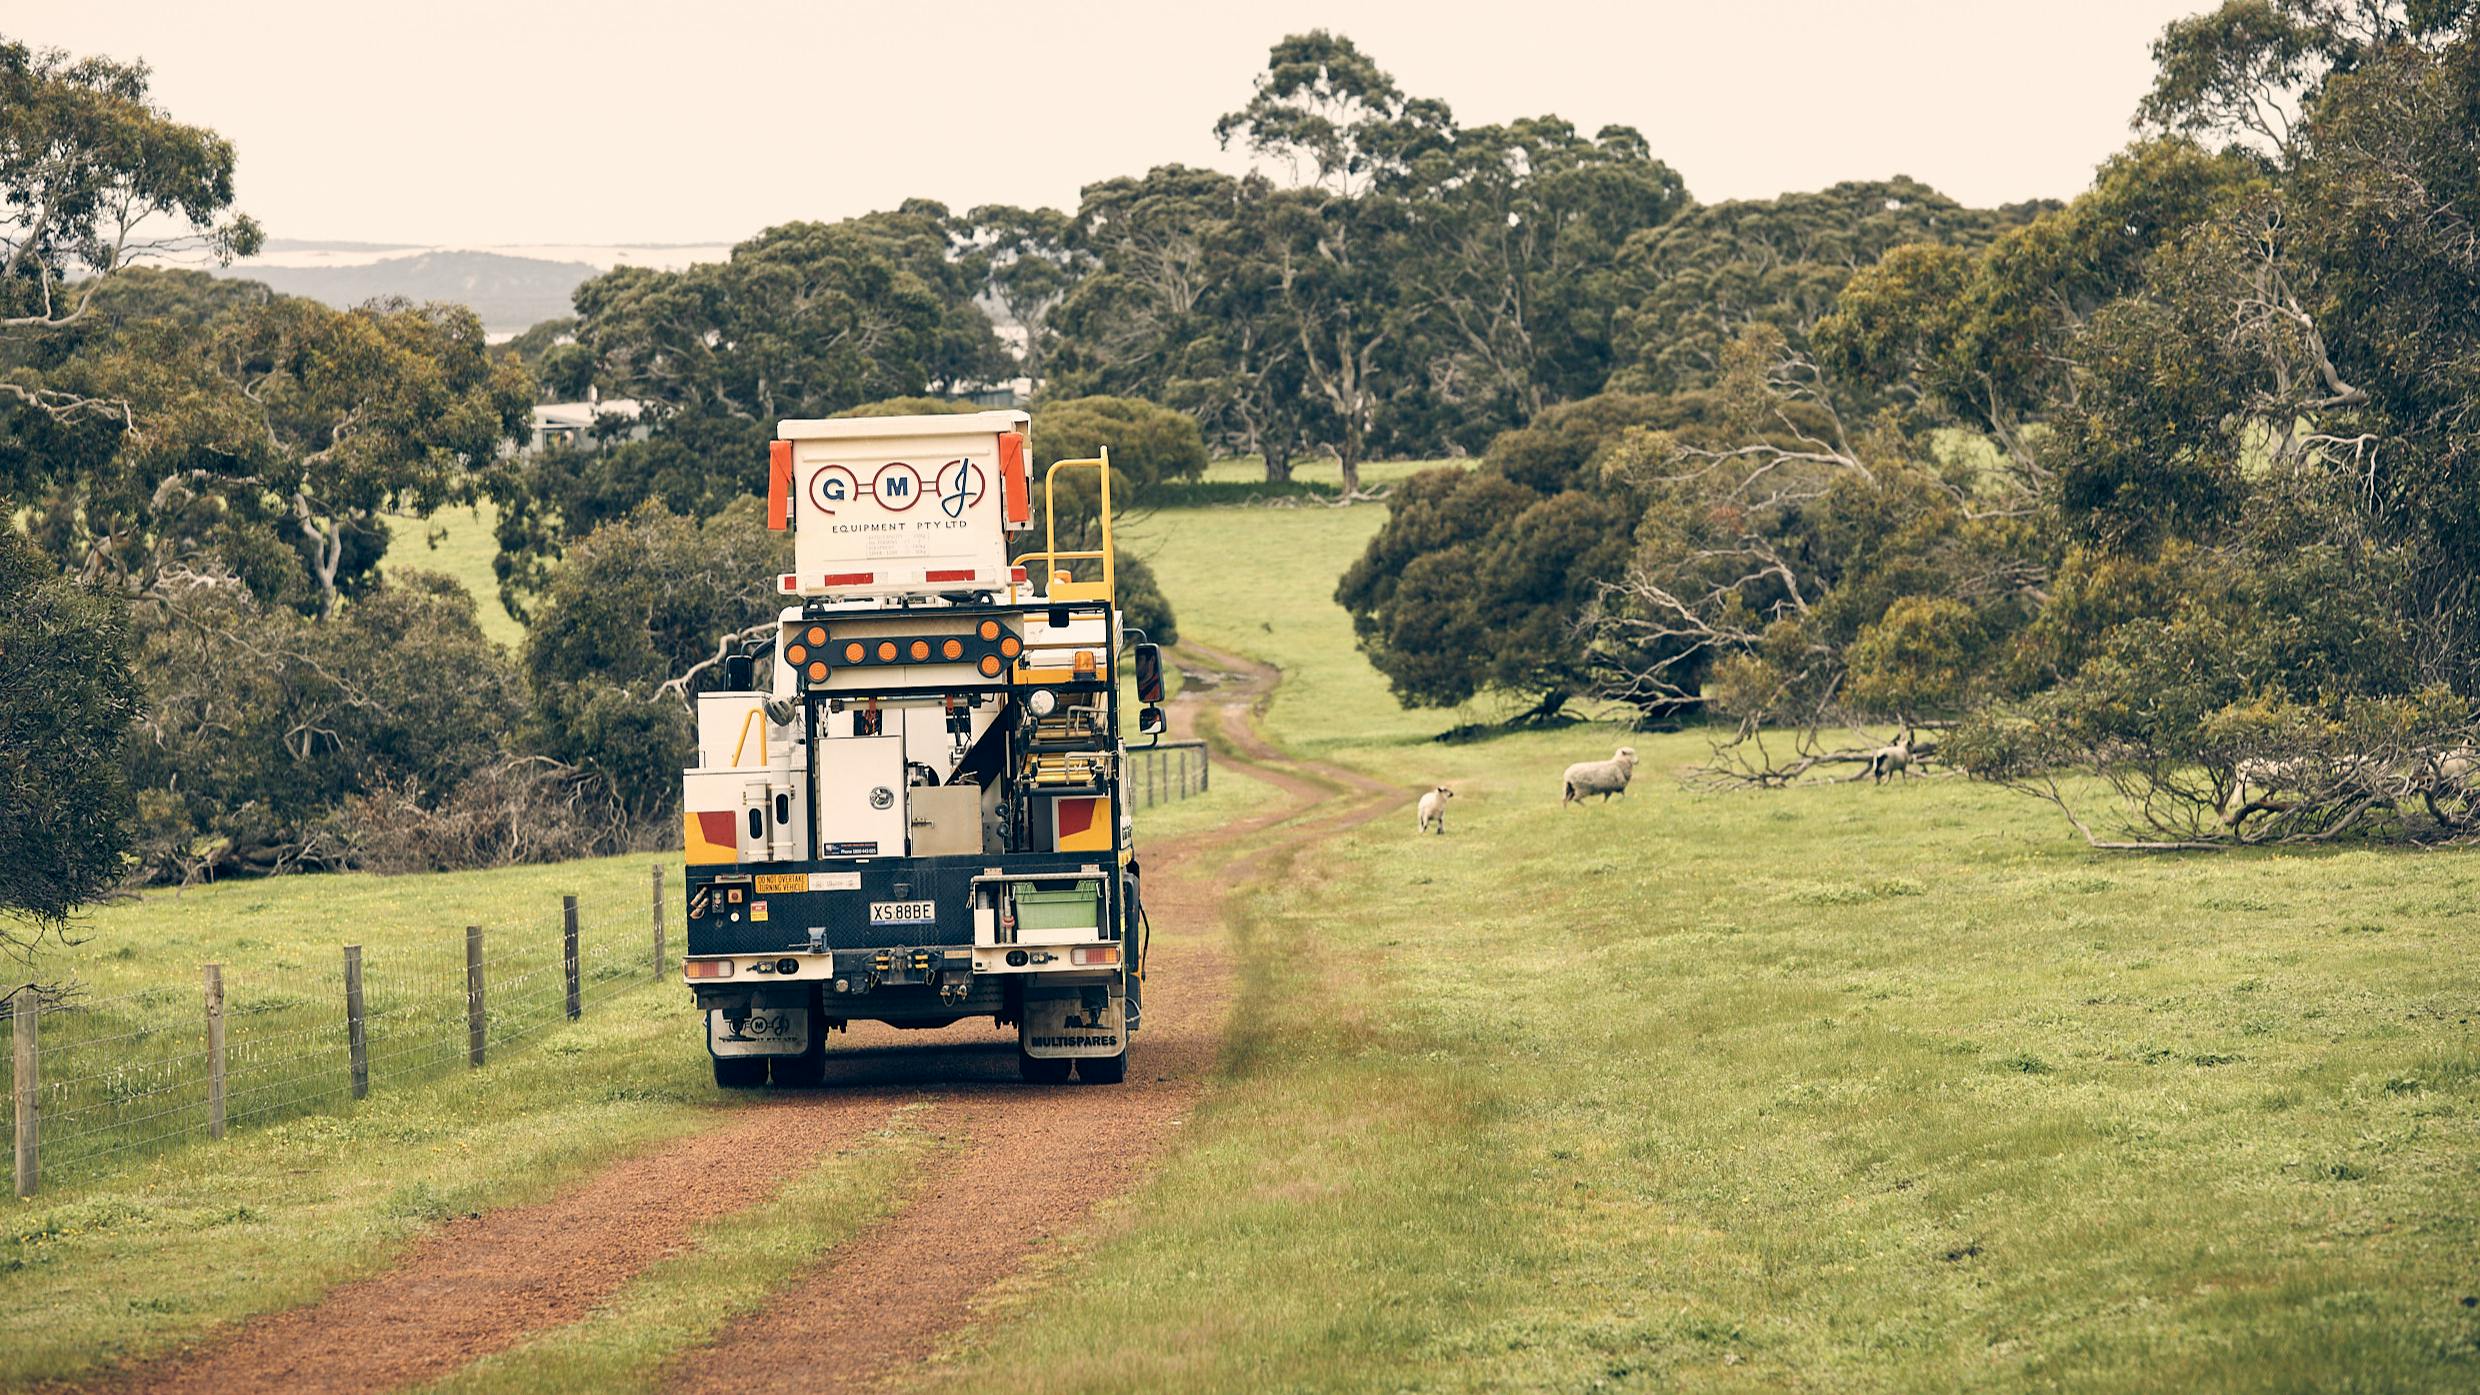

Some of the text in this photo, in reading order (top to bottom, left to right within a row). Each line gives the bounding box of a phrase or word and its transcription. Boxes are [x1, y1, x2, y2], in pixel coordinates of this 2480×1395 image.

[822, 478, 845, 501] G
[886, 476, 908, 497] M
[832, 519, 967, 534] EQUIPMENT PTY LTD
[757, 875, 766, 884] DO
[767, 875, 777, 883] NOT
[778, 874, 804, 883] OVERTAKE
[757, 883, 782, 892] TURNING
[783, 882, 804, 891] VEHICLE
[1031, 1035, 1117, 1047] MULTISPARES
